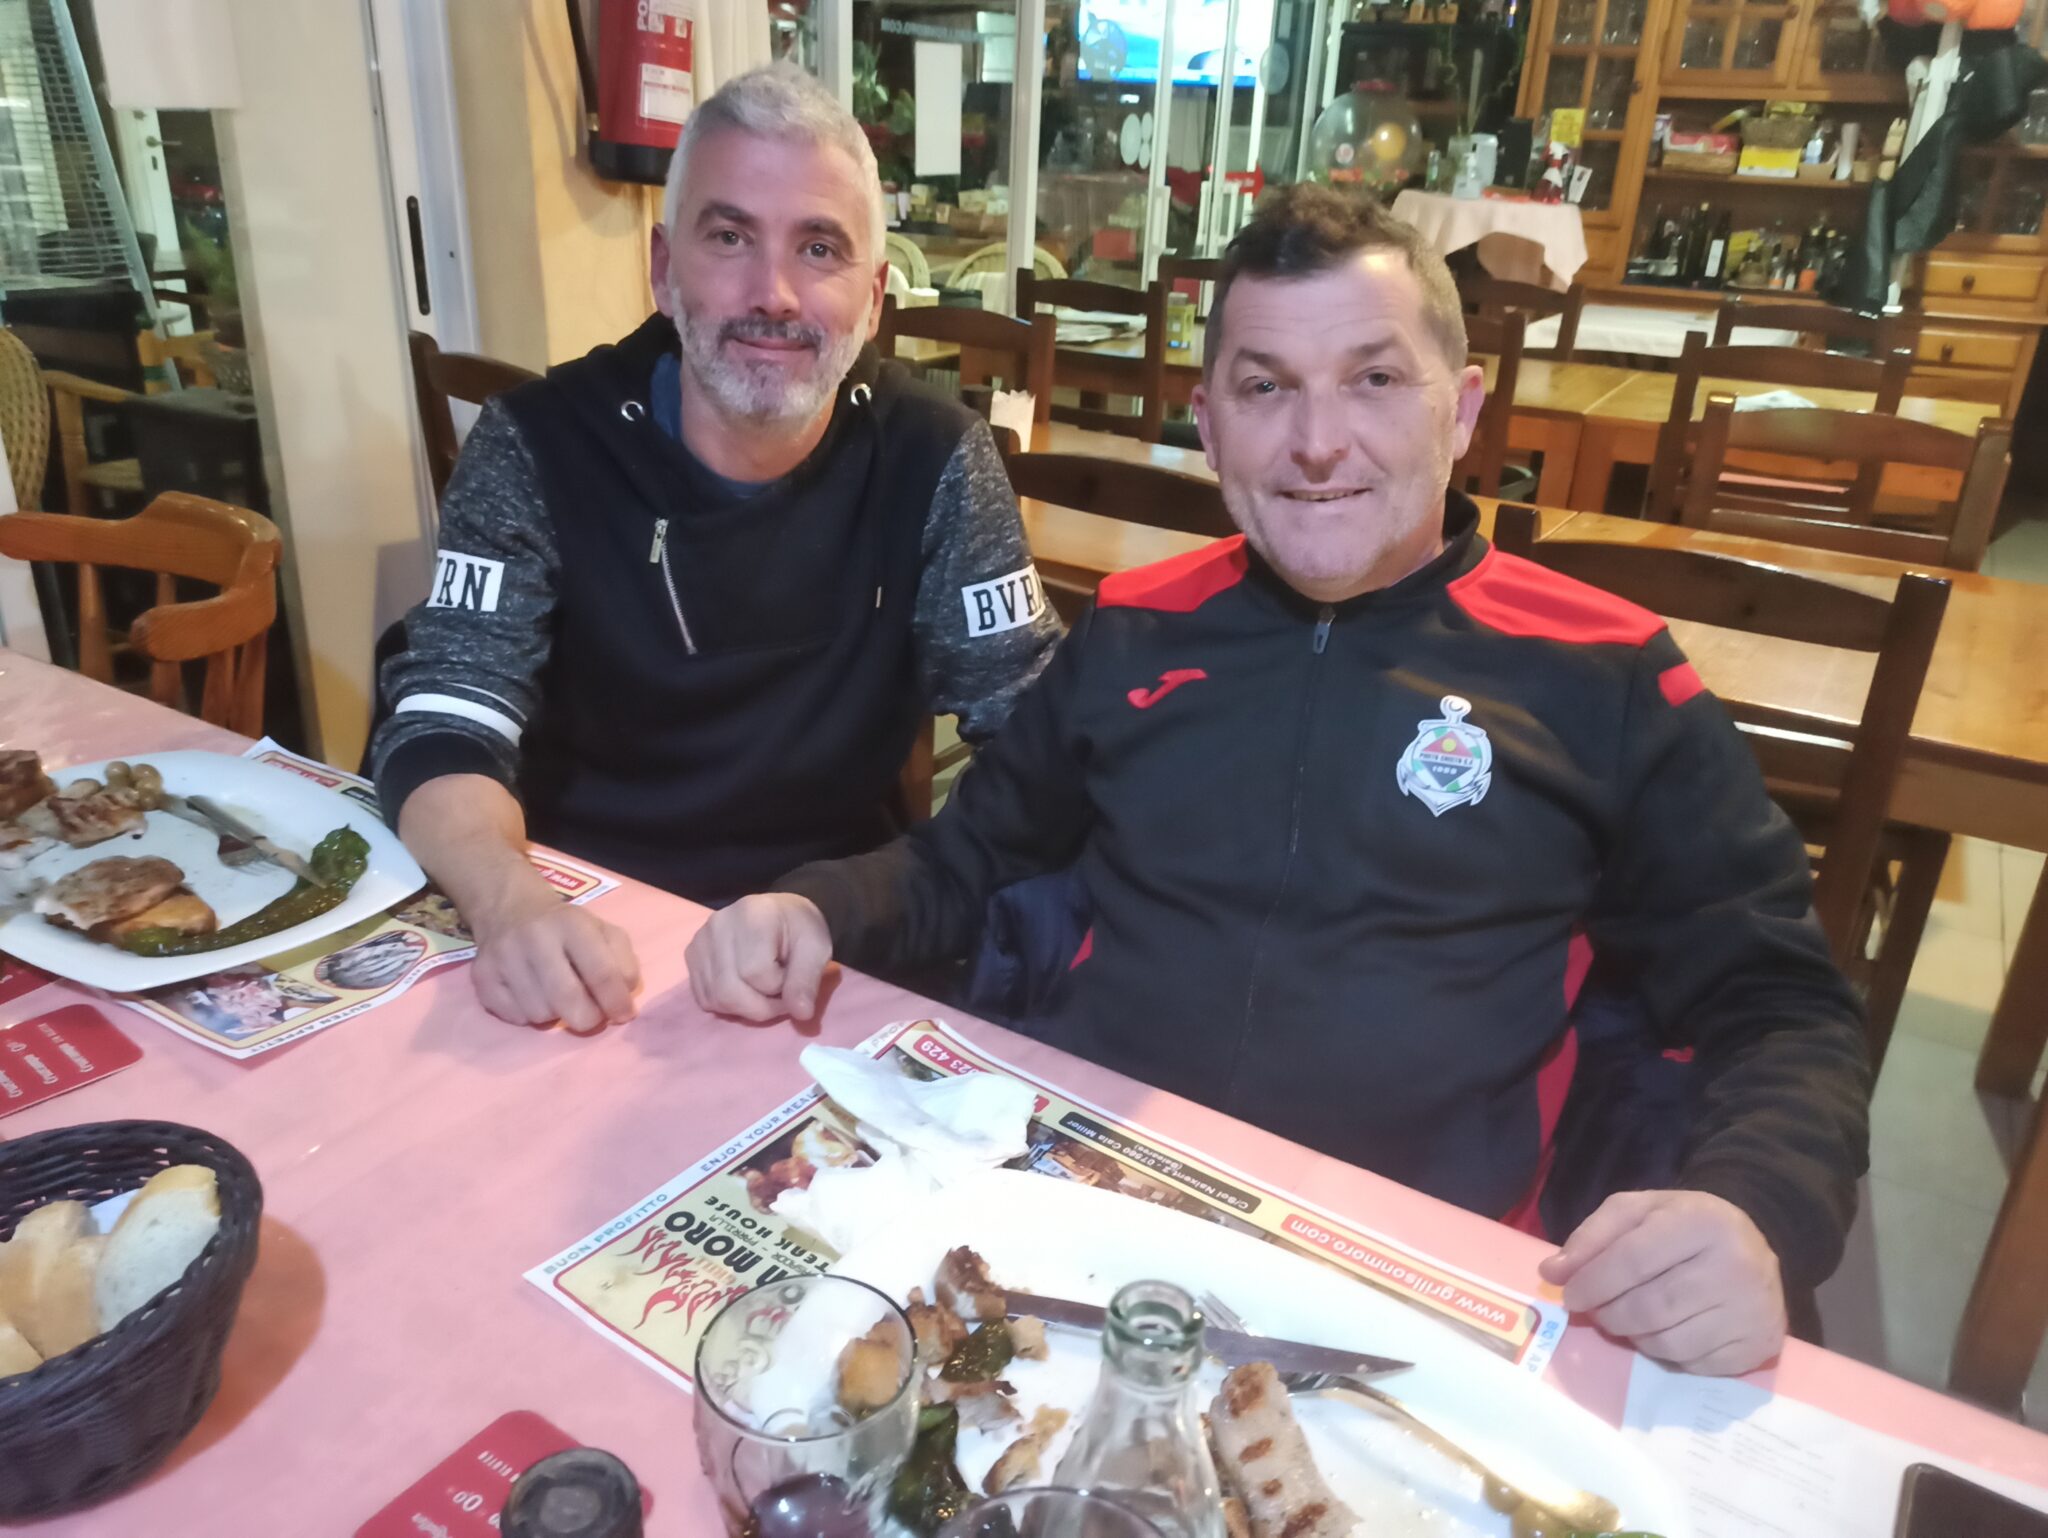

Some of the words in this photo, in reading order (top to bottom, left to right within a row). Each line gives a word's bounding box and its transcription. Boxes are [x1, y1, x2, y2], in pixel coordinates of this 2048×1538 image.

[437, 557, 491, 612] RN
[972, 570, 1041, 632] BVR
[920, 1040, 950, 1063] 429
[700, 1141, 744, 1173] ENJOY
[745, 1115, 781, 1142] YOUR
[782, 1090, 818, 1119] MEAL
[543, 1243, 592, 1275] BUON
[593, 1193, 668, 1244] PROFITTO
[664, 1211, 763, 1273] MORO
[704, 1195, 773, 1239] HOUSE
[774, 1237, 830, 1273] TEAK
[1290, 1219, 1507, 1325] www.grillsonmoro.com
